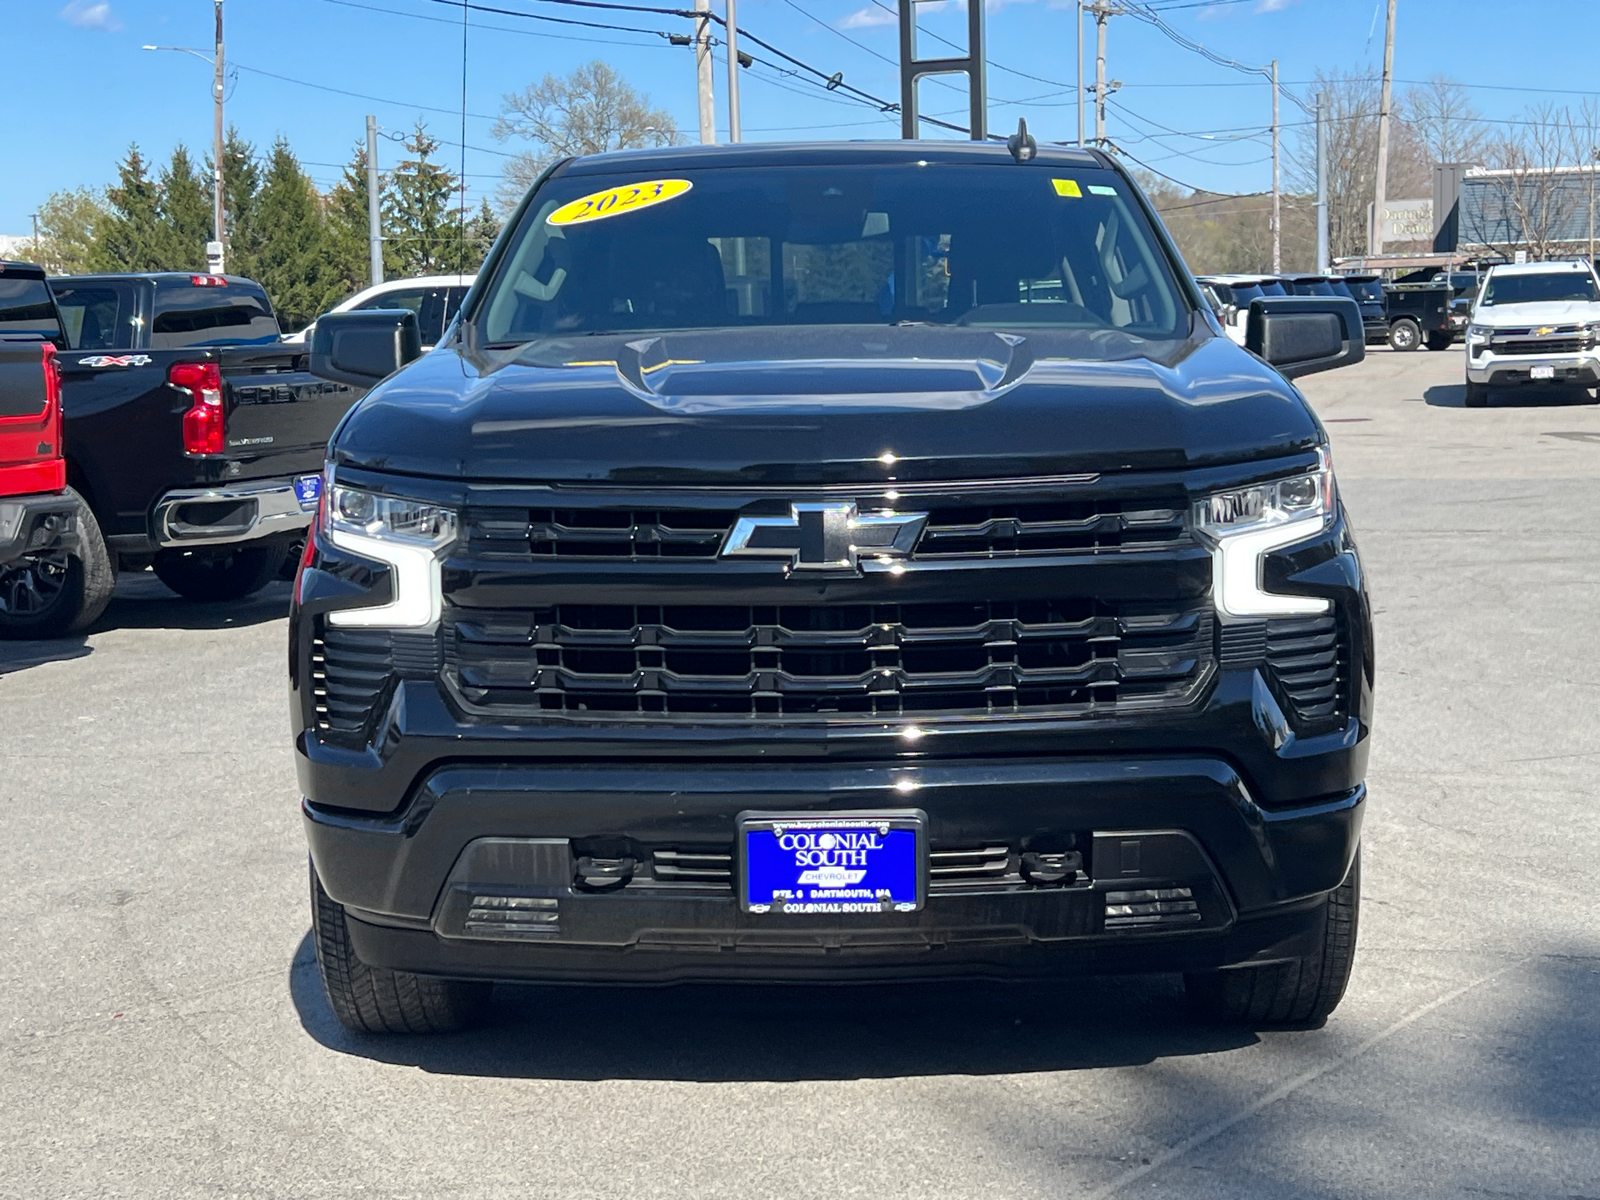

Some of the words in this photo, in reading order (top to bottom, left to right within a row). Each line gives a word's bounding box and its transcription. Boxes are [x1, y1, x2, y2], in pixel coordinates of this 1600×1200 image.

[571, 183, 664, 220] 2023
[779, 833, 883, 850] COLONIAL
[795, 850, 867, 866] SOUTH
[796, 890, 804, 899] 6
[810, 889, 874, 899] DARTMOUTH,
[875, 889, 891, 898] MA
[783, 903, 841, 913] COLONIAL
[842, 903, 881, 913] SOUTH
